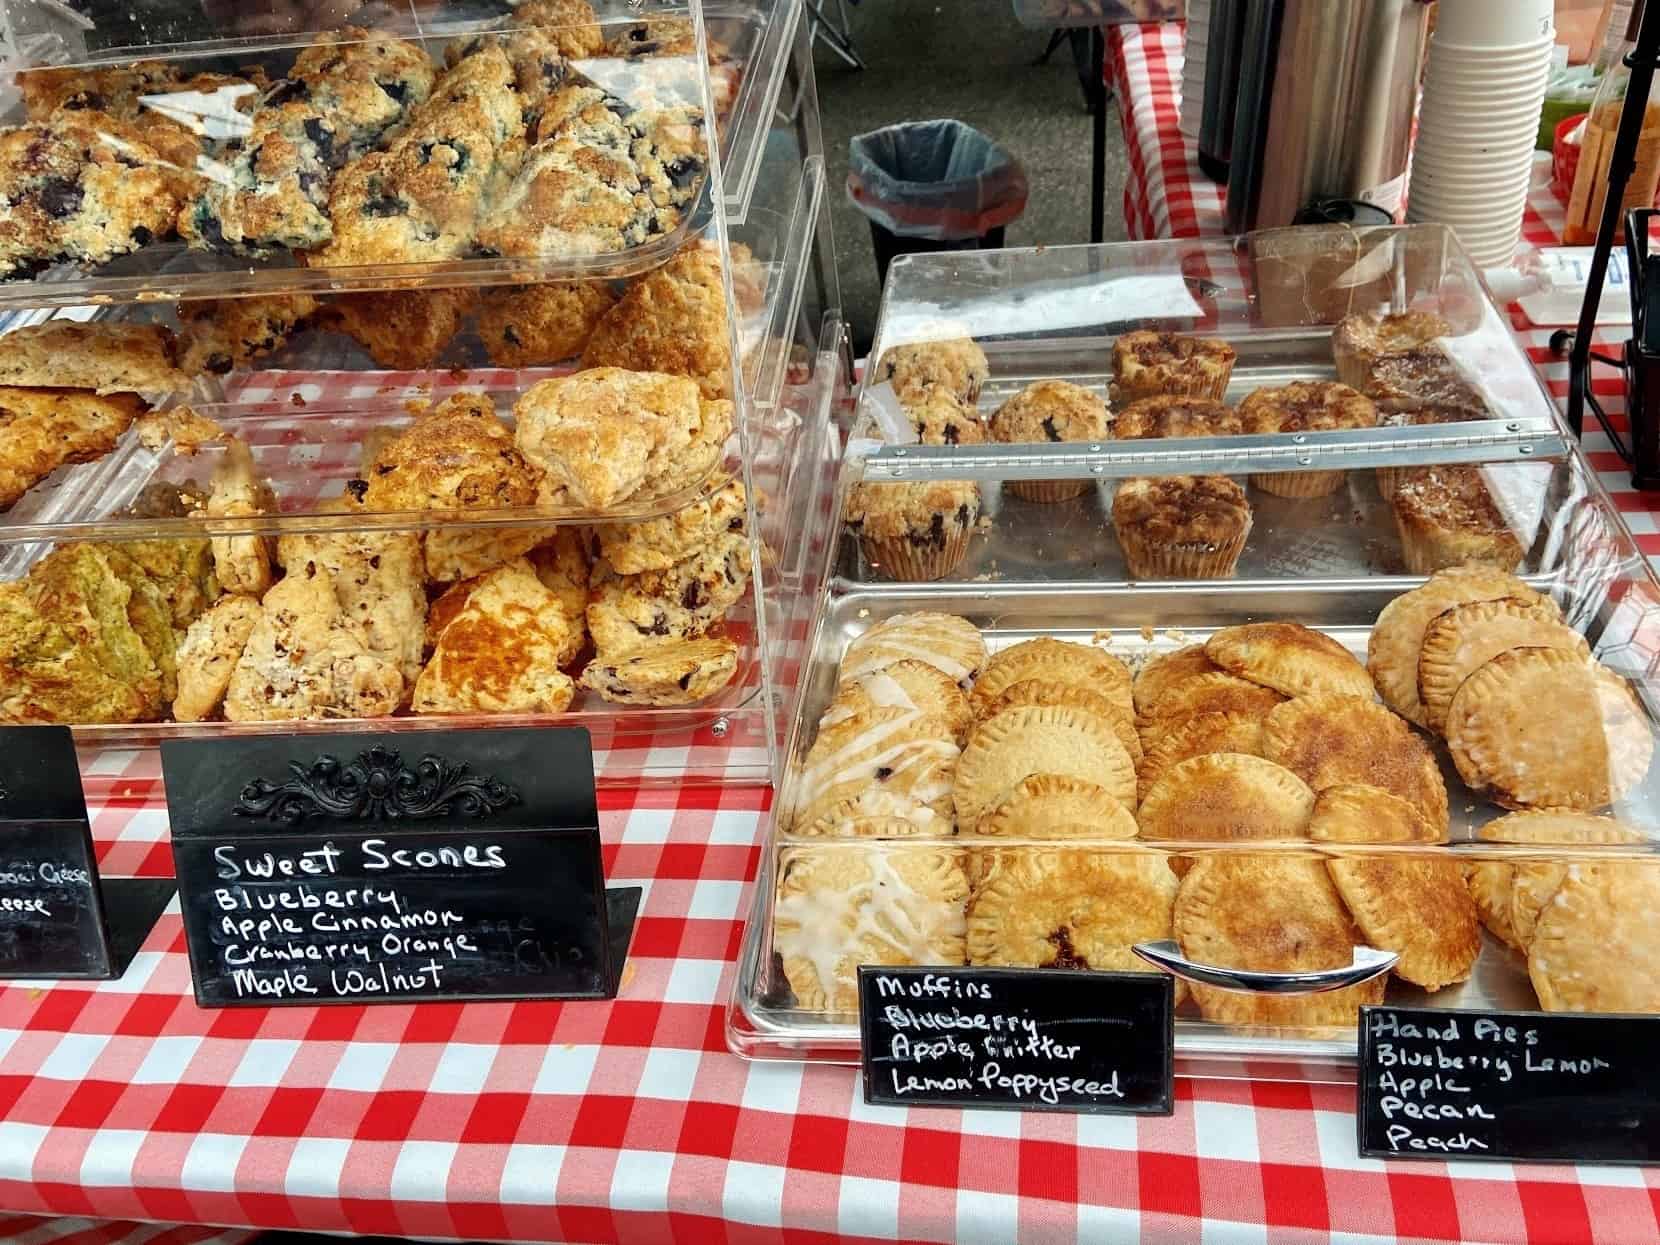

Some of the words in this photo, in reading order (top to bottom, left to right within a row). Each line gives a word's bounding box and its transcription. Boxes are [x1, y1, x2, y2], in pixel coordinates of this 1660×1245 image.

[214, 845, 341, 878] Sweet
[361, 839, 507, 869] Scones
[0, 897, 52, 916] eese
[215, 885, 402, 914] Blueberry
[222, 912, 303, 941] Apple
[311, 909, 463, 931] Cinnamon
[225, 942, 371, 965] Cranberry
[382, 933, 477, 959] Orange
[233, 967, 318, 998] Maple
[331, 958, 443, 995] Walnut
[876, 974, 992, 999] Muffins
[885, 1005, 1038, 1040] Blueberry
[1371, 1012, 1460, 1041] Hand
[891, 1033, 974, 1063] Apple
[1376, 1043, 1513, 1081] Blueberry
[1525, 1049, 1609, 1074] Lemon
[892, 1068, 973, 1094] Lemon
[978, 1062, 1125, 1103] Poppyseed
[1379, 1072, 1471, 1098] Apple
[1380, 1095, 1496, 1121] Pecan
[1386, 1124, 1489, 1151] Peach
